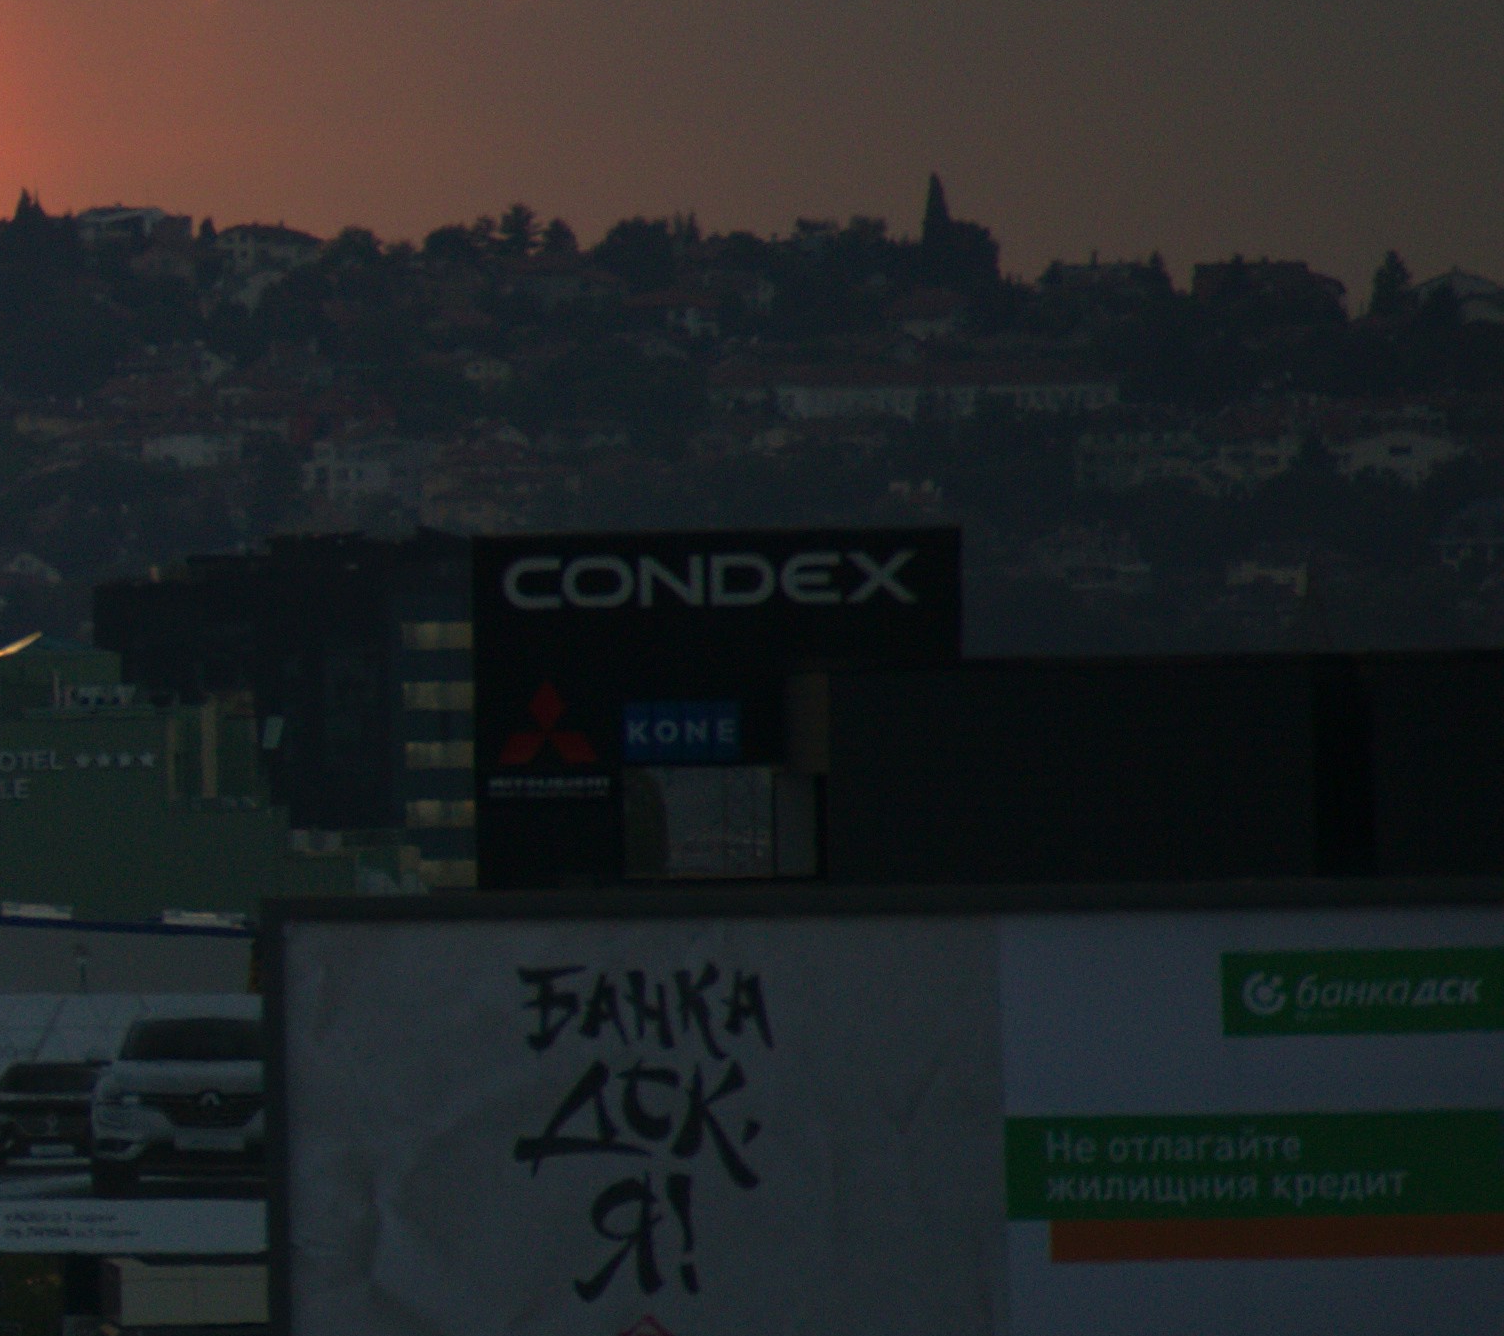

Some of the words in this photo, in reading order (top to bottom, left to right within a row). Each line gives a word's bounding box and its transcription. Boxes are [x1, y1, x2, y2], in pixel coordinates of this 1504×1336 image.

[501, 547, 921, 610] CONDEX
[626, 716, 742, 748] KONE
[517, 962, 774, 1056] БАНКА
[1045, 1128, 1098, 1165] Не
[1106, 1129, 1302, 1171] отлагайте
[1045, 1167, 1261, 1205] жилищния
[1273, 1163, 1408, 1206] кредит
[573, 1173, 700, 1303] Я!
